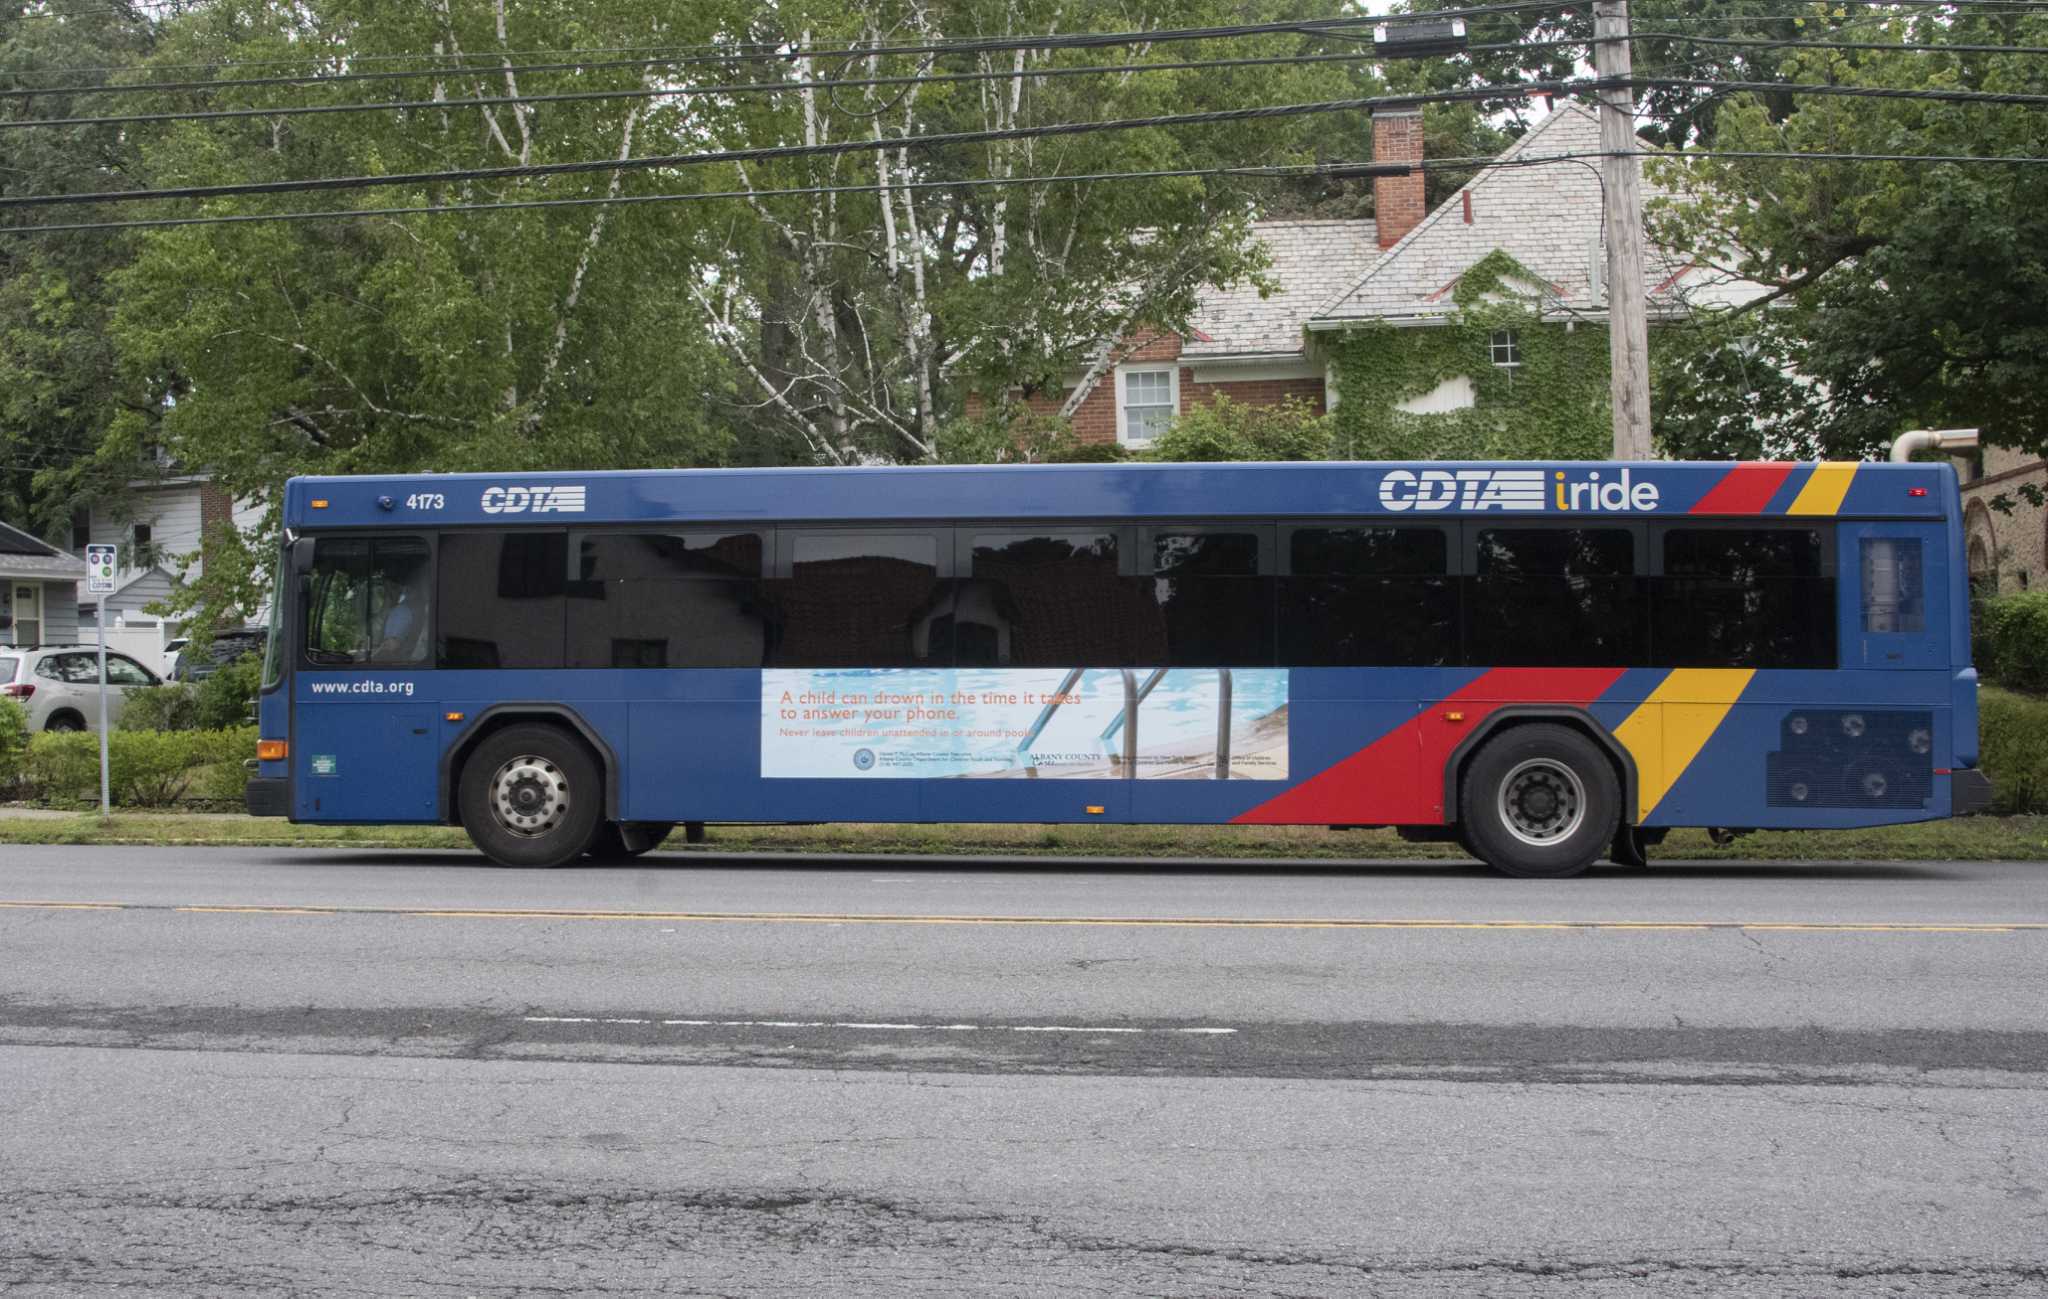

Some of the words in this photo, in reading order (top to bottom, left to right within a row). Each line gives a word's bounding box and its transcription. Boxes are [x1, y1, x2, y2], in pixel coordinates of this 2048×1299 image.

[1378, 469, 1545, 512] CDTA
[405, 493, 445, 510] 4173
[480, 485, 586, 514] CDTA
[311, 680, 415, 696] www.cdta.org
[780, 690, 793, 705] A
[799, 688, 836, 705] child
[841, 693, 868, 705] can
[873, 690, 924, 705] drown
[931, 691, 944, 705] in
[951, 691, 977, 705] the
[982, 691, 1017, 705] time
[1023, 691, 1035, 705] it
[1040, 691, 1082, 705] takes
[780, 708, 797, 720] to
[803, 709, 859, 720] answer
[864, 709, 901, 724] your
[906, 706, 960, 724] phone.
[779, 727, 810, 737] Never
[812, 727, 837, 737] leave
[840, 727, 879, 737] children
[881, 727, 937, 737] unattended
[951, 729, 961, 737] or
[967, 728, 1003, 737] around
[1065, 753, 1101, 761] COUNTY
